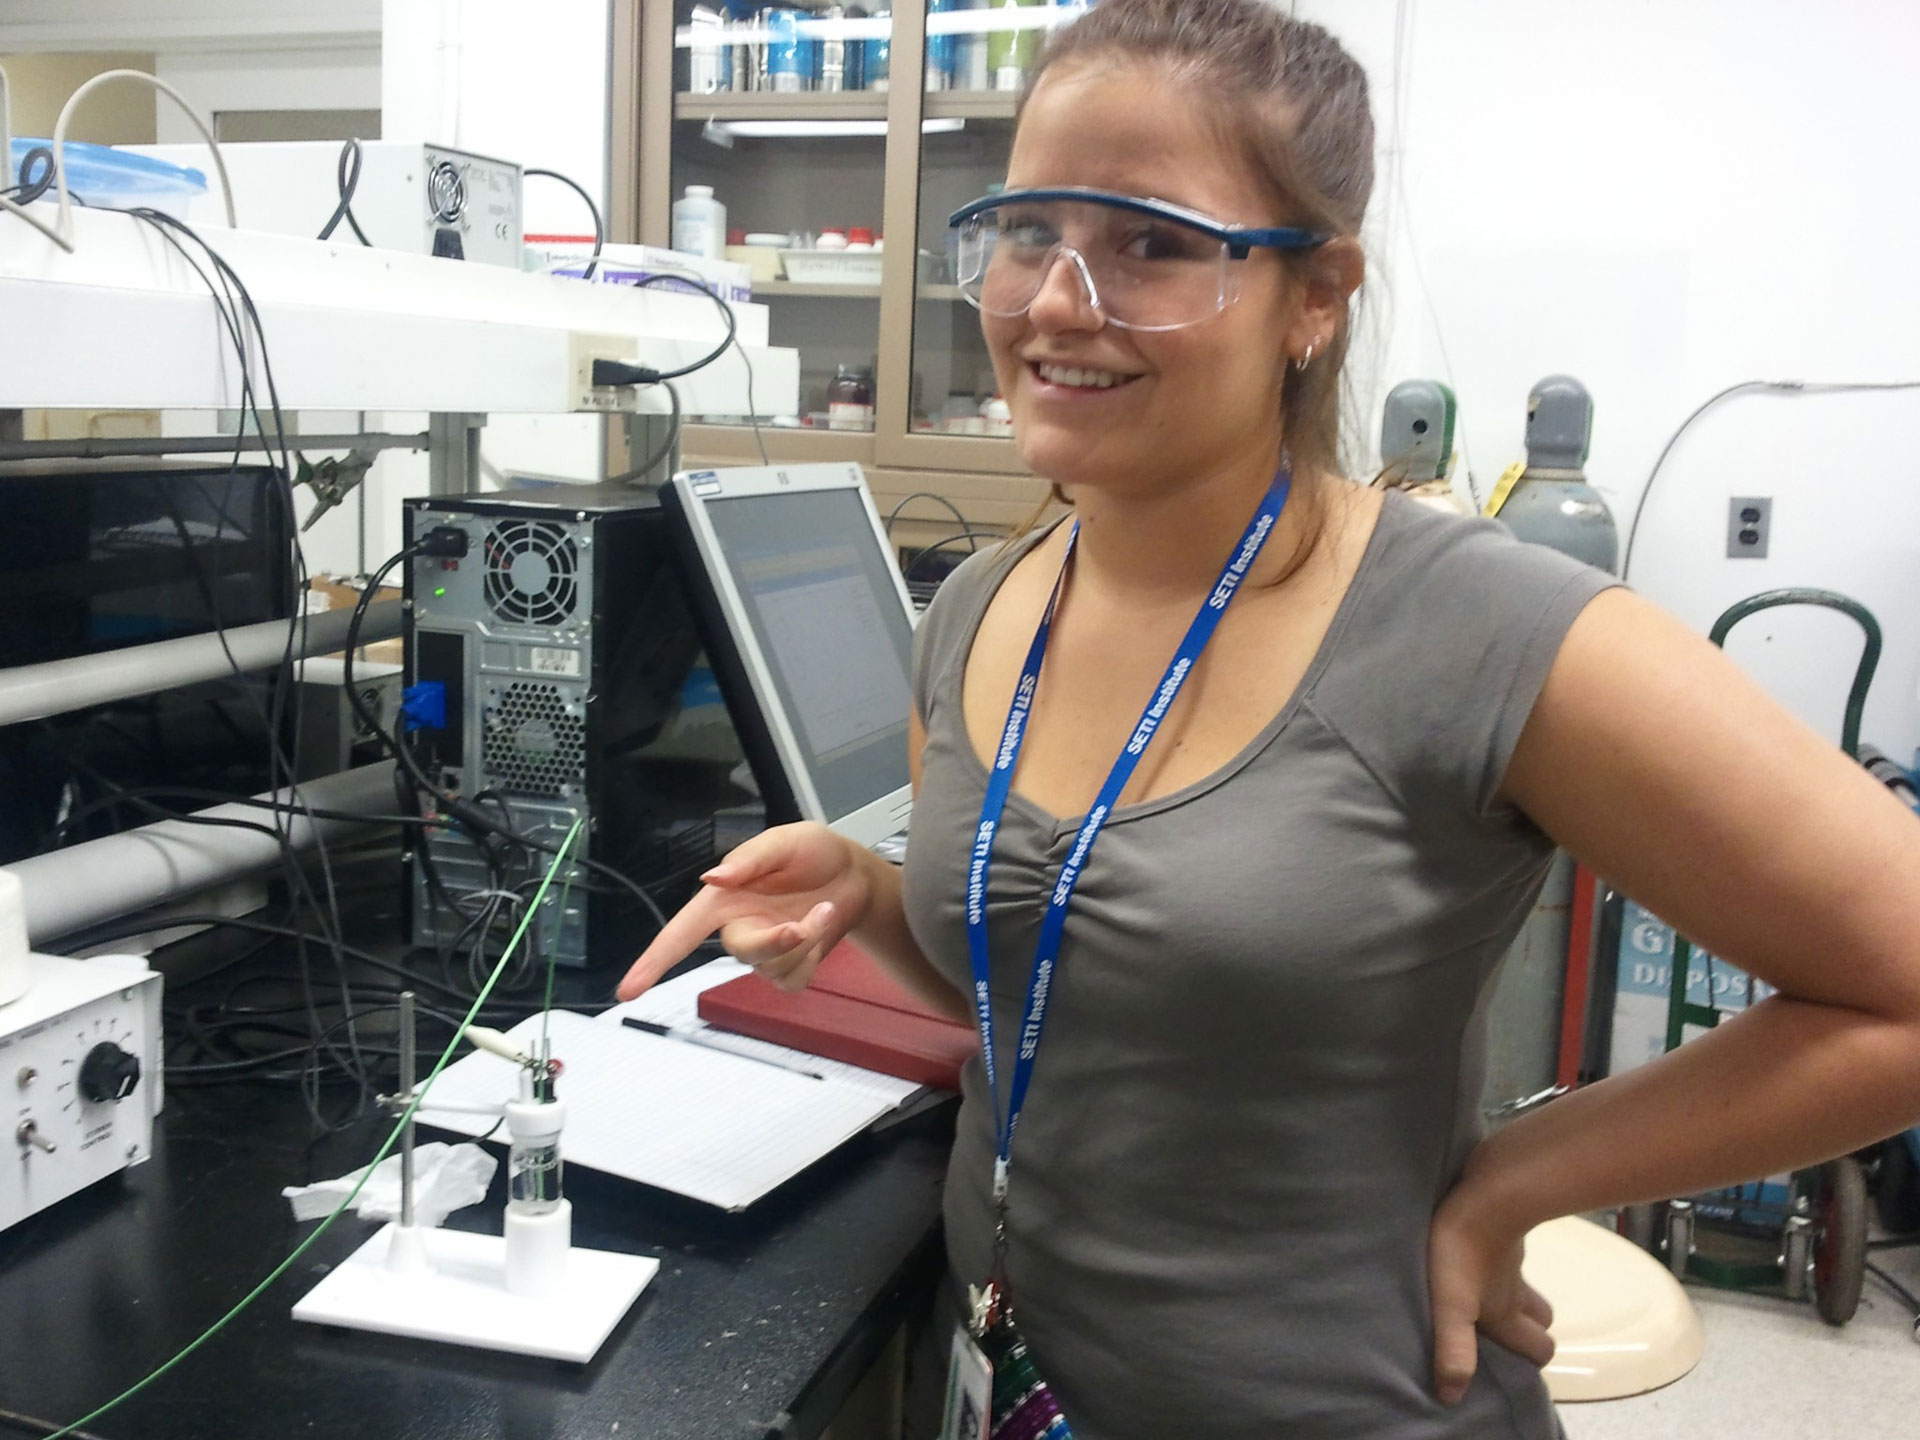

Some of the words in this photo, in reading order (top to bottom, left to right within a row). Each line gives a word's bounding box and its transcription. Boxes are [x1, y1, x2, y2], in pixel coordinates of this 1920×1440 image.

[1209, 572, 1240, 610] SETI
[1230, 514, 1274, 573] Institute
[1014, 673, 1036, 710] SETI
[1127, 717, 1157, 755] SETI
[1147, 658, 1191, 719] Institute
[996, 709, 1026, 770] Institute
[974, 820, 995, 857] SETI
[1052, 867, 1076, 907] SETI
[1067, 805, 1108, 868] Institute
[968, 859, 987, 926] Institute
[1026, 959, 1053, 1021] Institute
[1020, 1023, 1040, 1060] SETI
